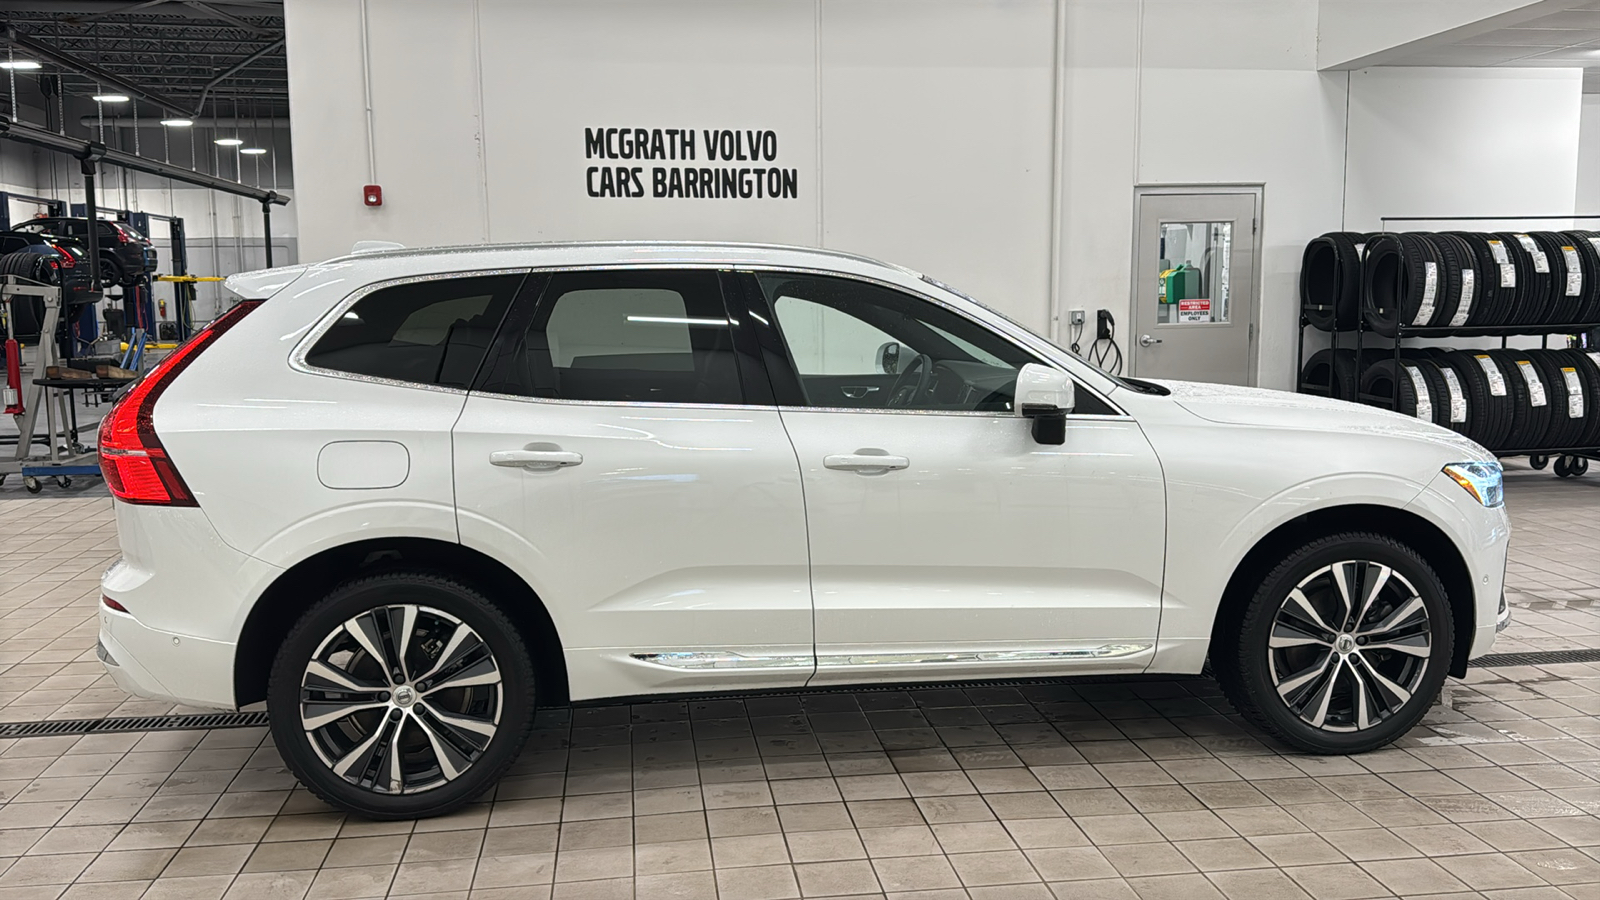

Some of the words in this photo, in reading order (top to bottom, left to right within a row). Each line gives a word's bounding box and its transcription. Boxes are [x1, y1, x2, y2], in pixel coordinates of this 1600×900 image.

[585, 127, 696, 160] MCGRATH
[703, 129, 777, 161] VOLVO
[586, 166, 645, 198] CARS
[652, 167, 798, 199] BARRINGTON
